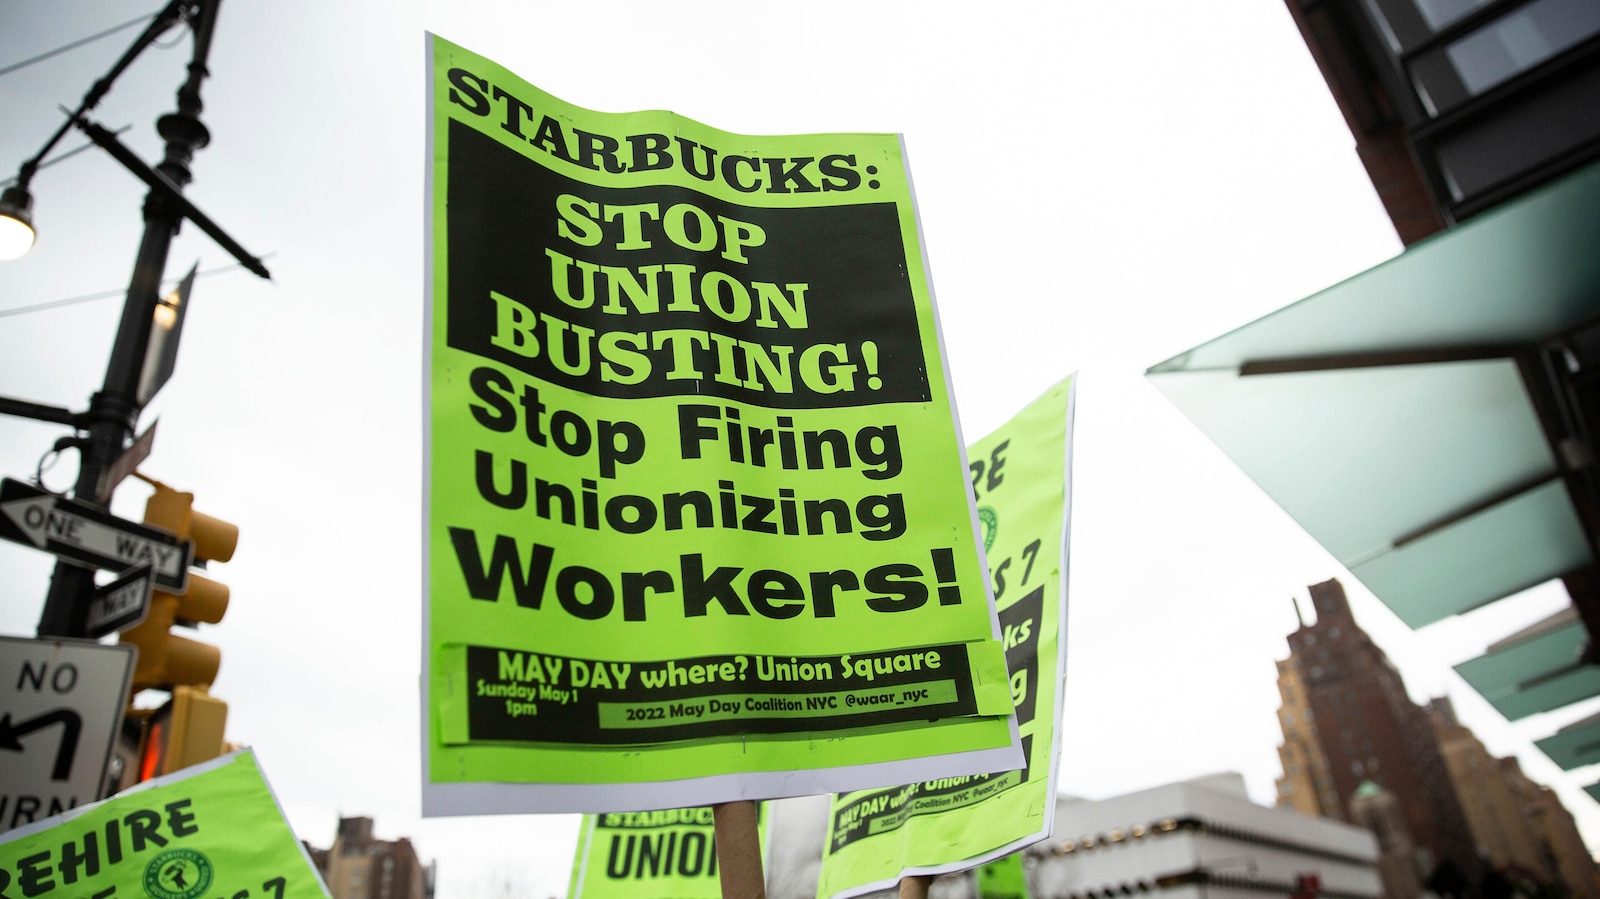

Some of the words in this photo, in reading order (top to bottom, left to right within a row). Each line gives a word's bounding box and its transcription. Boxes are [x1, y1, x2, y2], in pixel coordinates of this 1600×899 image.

[447, 67, 881, 194] STARBUCKS:
[556, 194, 766, 265] STOP
[545, 248, 808, 329] UNION
[490, 291, 883, 395] BUSTING!
[469, 366, 646, 479] Stop
[677, 404, 903, 480] Firing
[475, 449, 907, 541] Unionizing
[24, 504, 81, 539] ONE
[117, 534, 174, 569] WAY
[447, 525, 962, 622] Workers!
[17, 660, 78, 694] NO
[476, 679, 537, 701] Sunday
[539, 684, 569, 705] May
[572, 689, 578, 703] 1
[498, 651, 563, 685] MAY
[570, 659, 632, 690] DAY
[640, 656, 749, 689] where?
[755, 655, 833, 682] Union
[841, 651, 941, 681] Square
[506, 700, 538, 718] 1pm
[626, 707, 665, 721] 2022
[669, 703, 705, 718] May
[710, 700, 741, 714] Day
[745, 698, 802, 712] Coalition
[806, 696, 838, 710] NYC
[845, 689, 928, 707] @waar_nyc
[860, 795, 890, 818] DAY
[915, 798, 951, 810] Coalition
[953, 791, 969, 803] NYC
